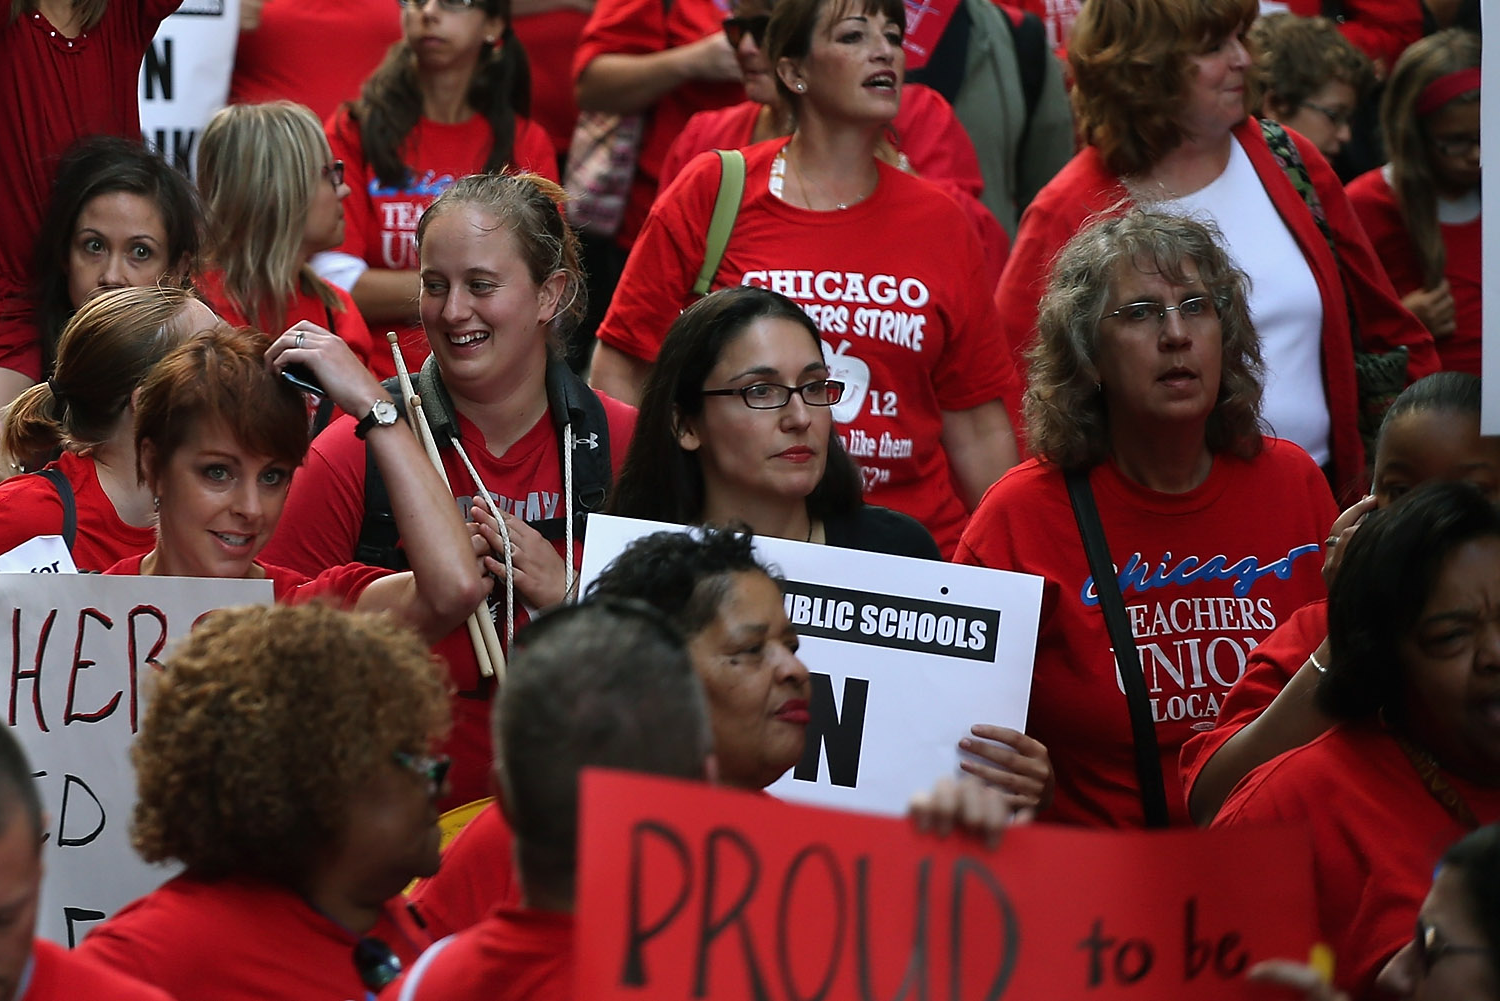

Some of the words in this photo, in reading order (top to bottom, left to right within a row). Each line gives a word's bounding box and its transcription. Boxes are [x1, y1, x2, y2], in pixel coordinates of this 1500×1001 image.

[145, 38, 174, 100] N
[741, 270, 930, 308] CHICAGO
[852, 307, 927, 352] STRIKE
[870, 390, 898, 416] 12
[849, 429, 877, 457] like
[879, 431, 914, 459] them
[1080, 543, 1320, 607] Chicago
[786, 593, 853, 632] UBLIC
[859, 605, 987, 652] SCHOOLS
[1125, 597, 1277, 639] EACHERS
[1109, 636, 1260, 698] UNIO
[793, 672, 870, 789] N
[1149, 692, 1219, 723] LOCA
[619, 820, 1020, 1001] PROUD
[1077, 916, 1153, 985] to
[1183, 900, 1247, 982] be
